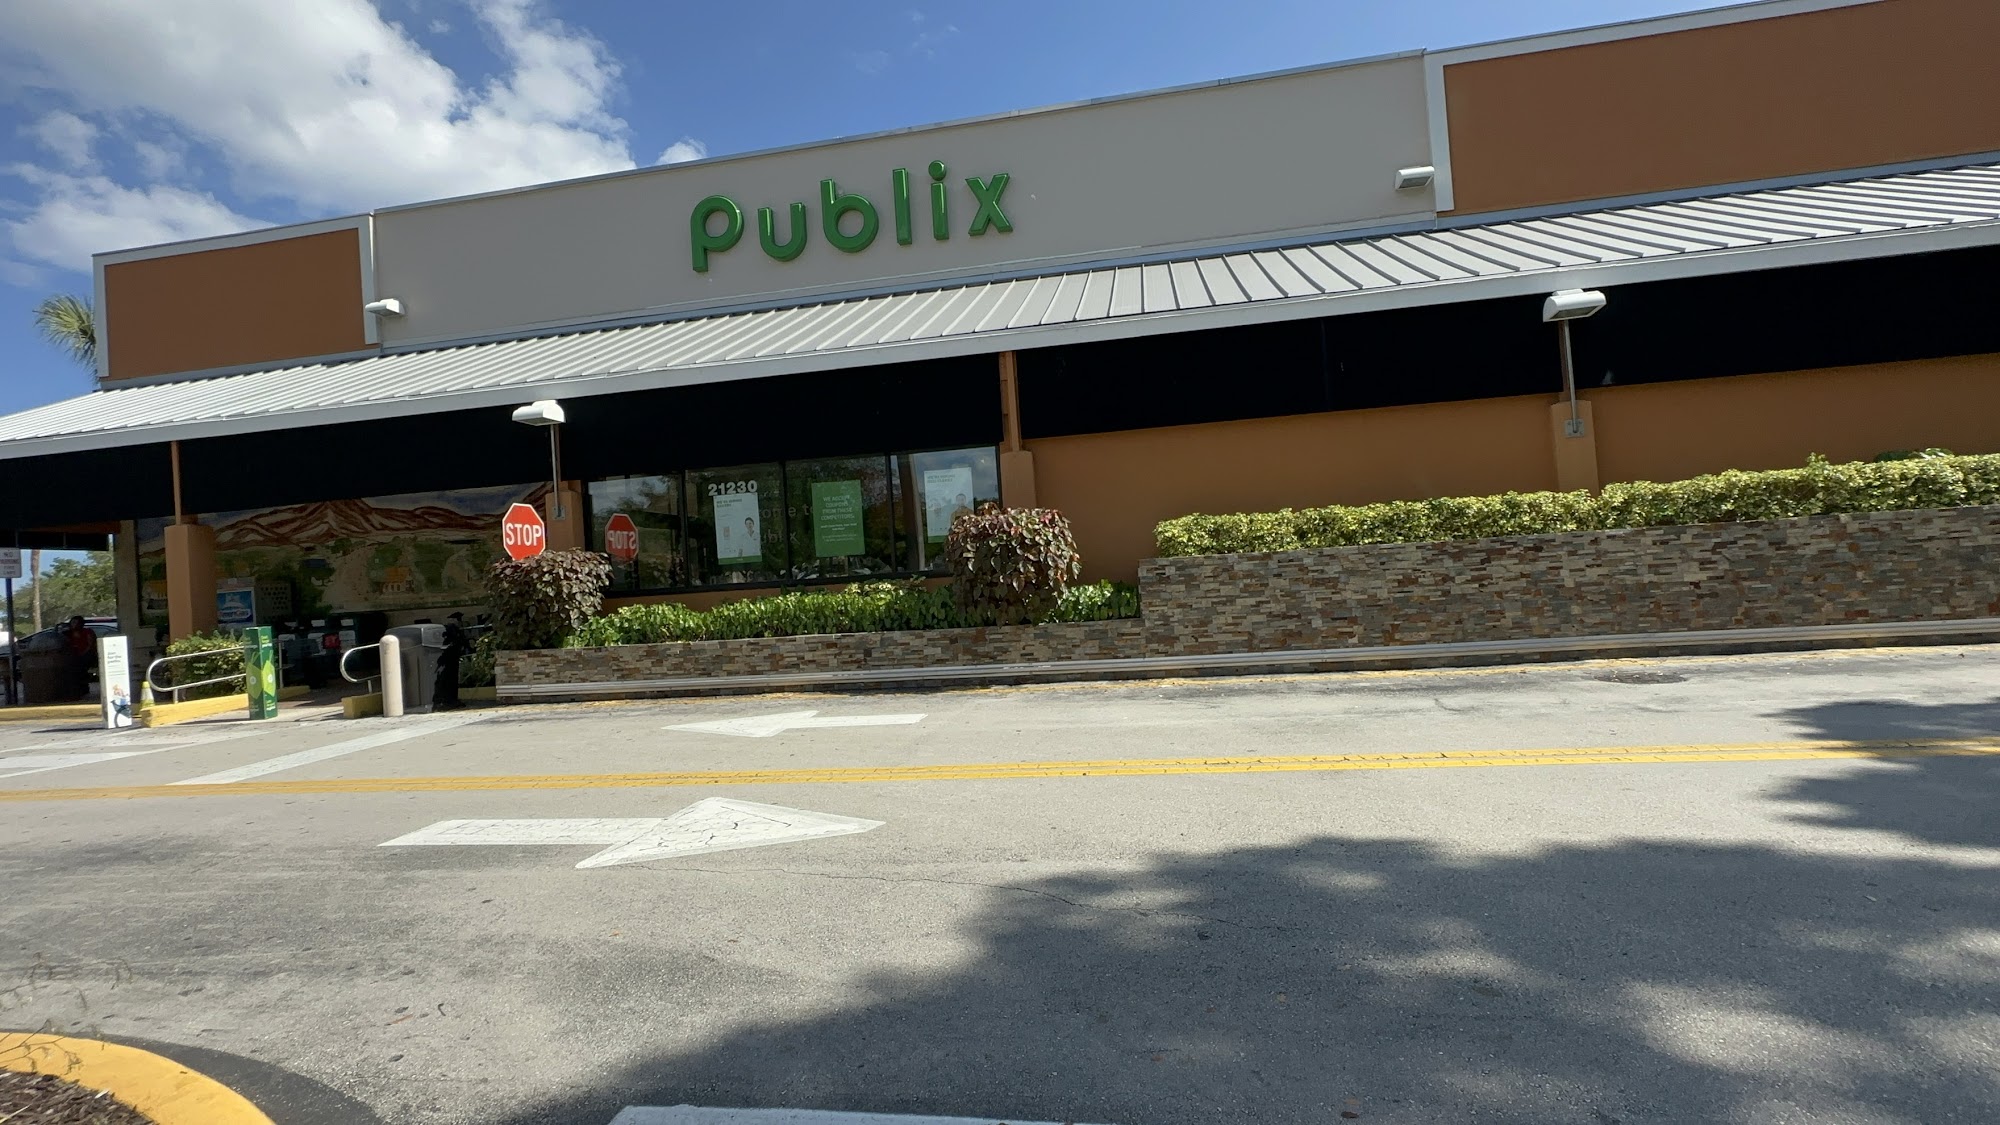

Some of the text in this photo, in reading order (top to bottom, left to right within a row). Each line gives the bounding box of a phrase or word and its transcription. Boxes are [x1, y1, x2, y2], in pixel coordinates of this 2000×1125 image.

[691, 160, 1013, 272] Publix
[708, 480, 757, 496] 21230
[506, 523, 542, 546] STOP
